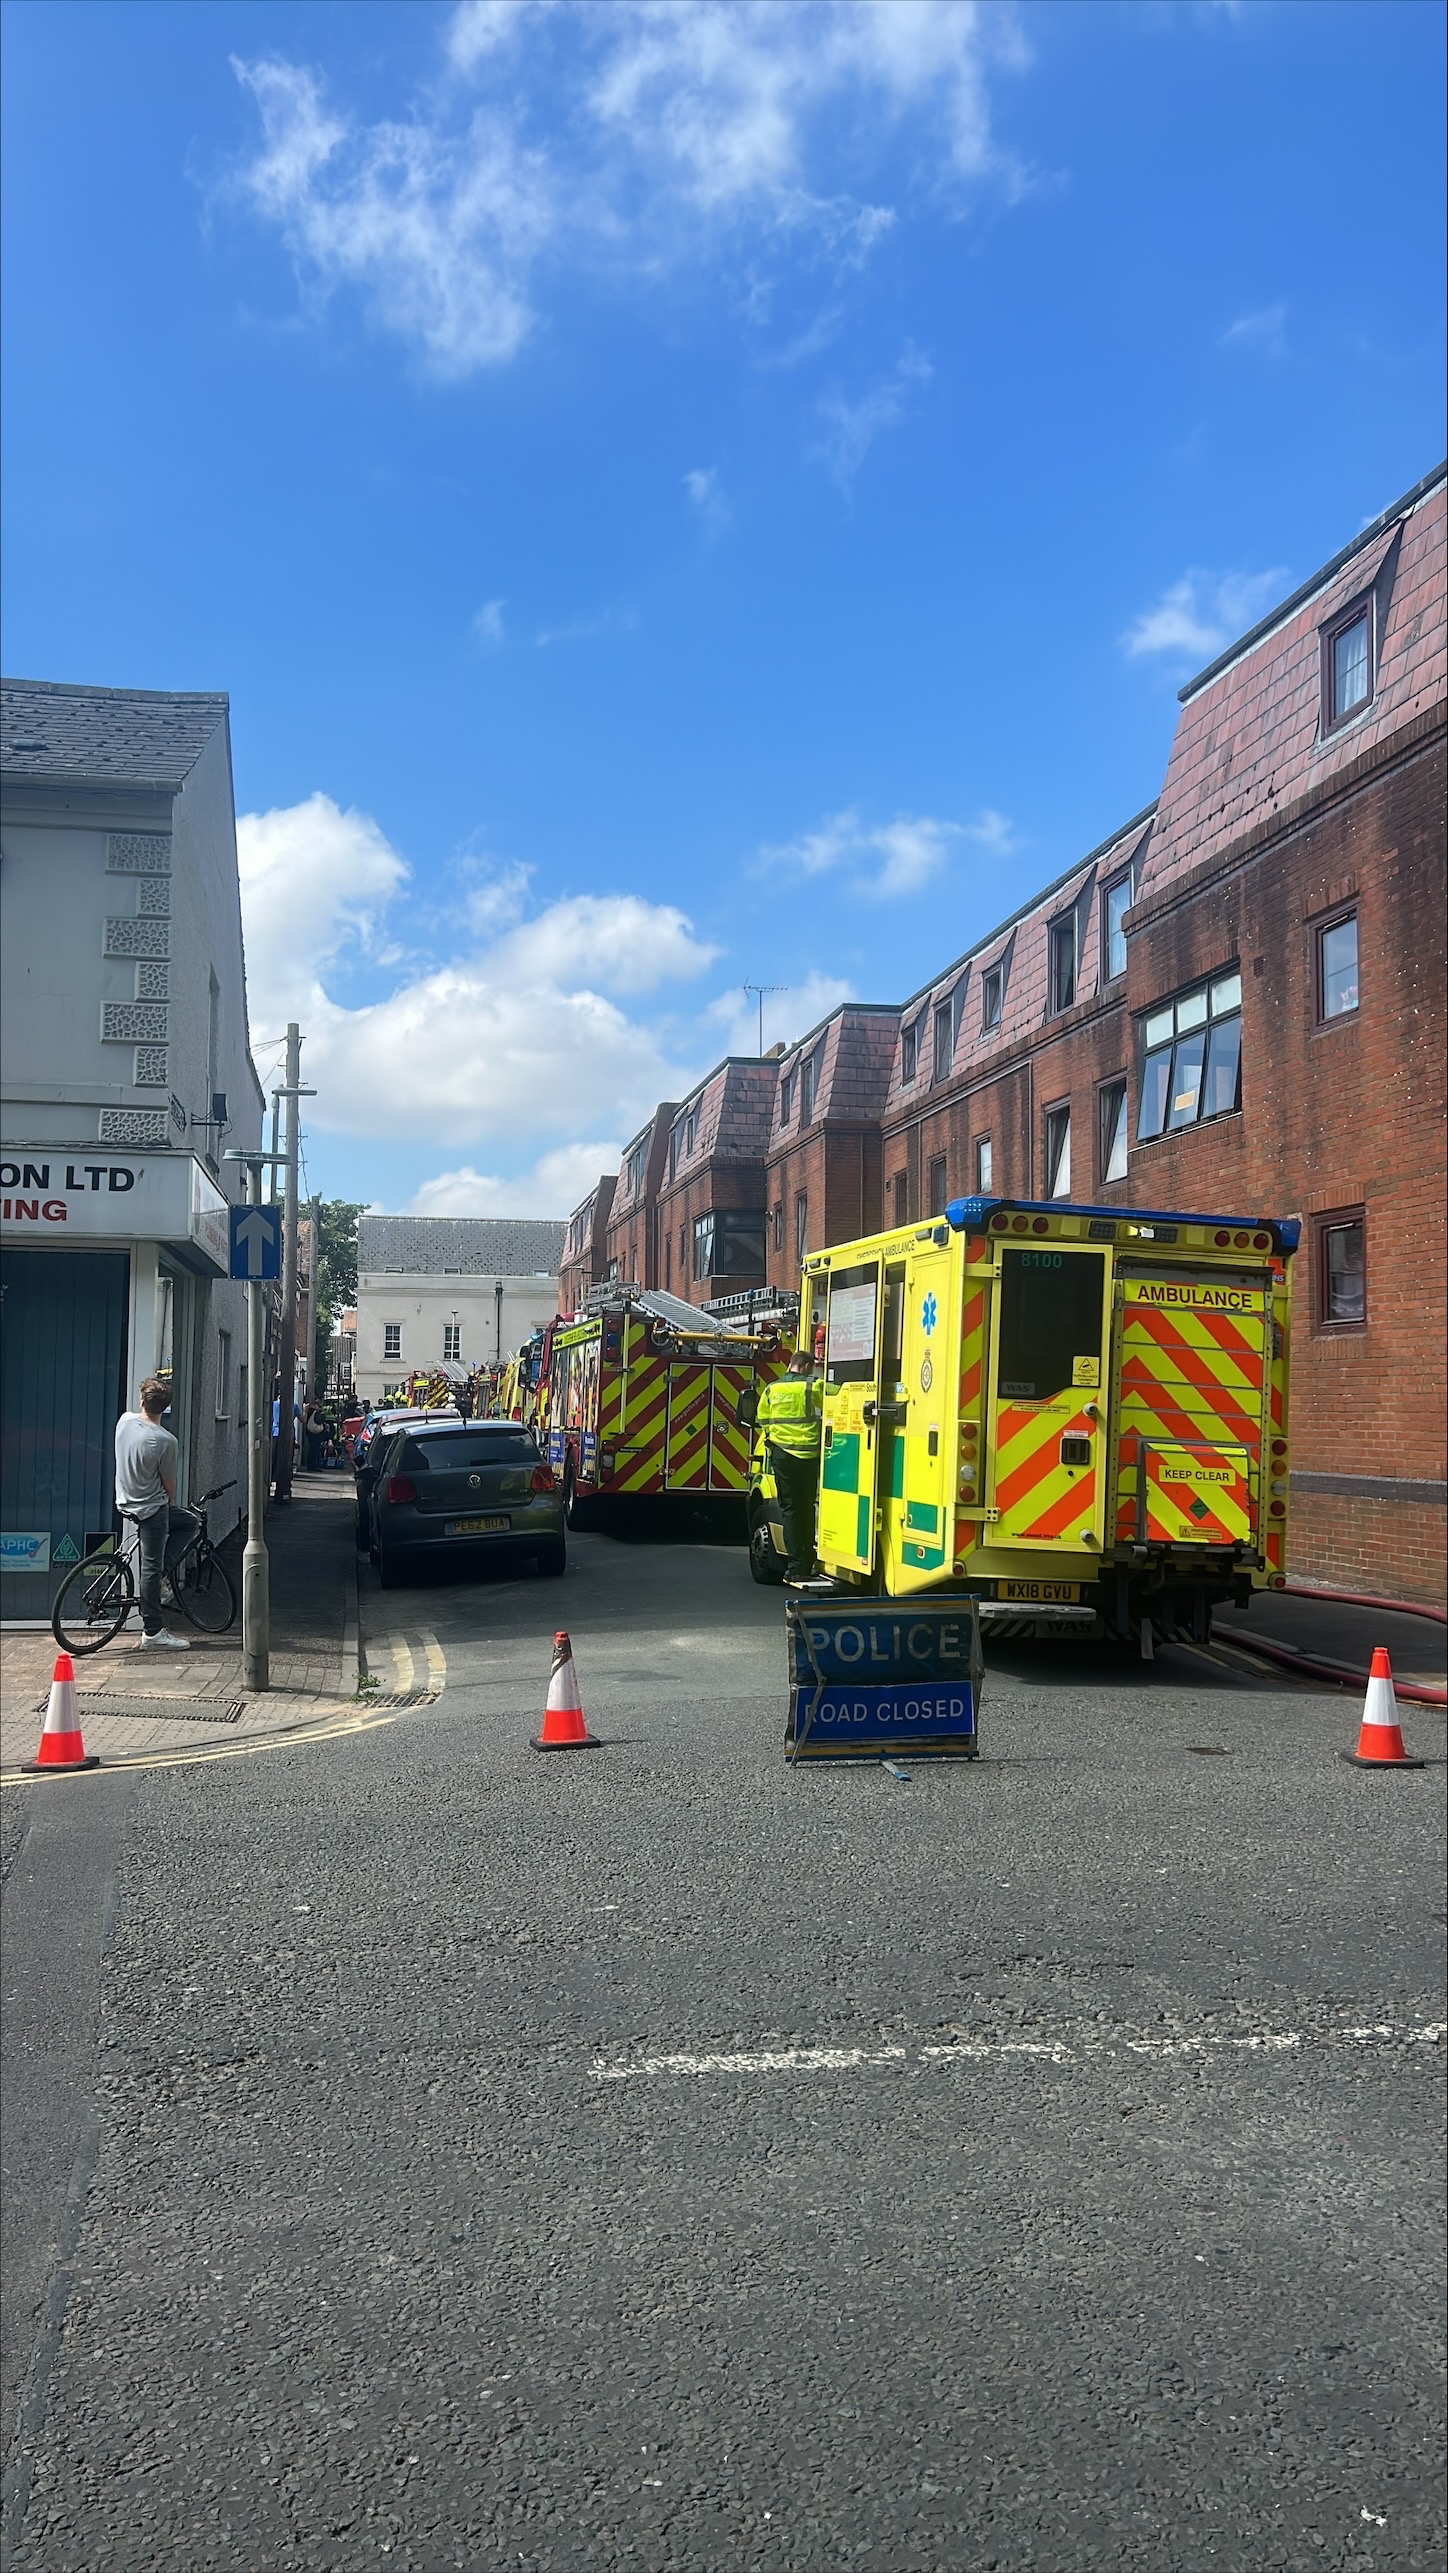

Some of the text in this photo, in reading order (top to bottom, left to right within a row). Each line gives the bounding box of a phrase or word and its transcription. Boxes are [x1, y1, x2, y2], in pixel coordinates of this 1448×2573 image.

[66, 1165, 135, 1192] LTD
[0, 1199, 67, 1221] ING
[885, 1239, 915, 1257] AMBULANCE
[1020, 1252, 1063, 1268] 8100
[1137, 1285, 1253, 1309] AMBULANCE
[1006, 1384, 1030, 1392] WAS
[1164, 1469, 1229, 1482] KEEP CLEAR
[1007, 1582, 1072, 1600] WX18 GVU
[805, 1623, 961, 1663] POLICE
[804, 1698, 964, 1723] ROAD CLOSED
